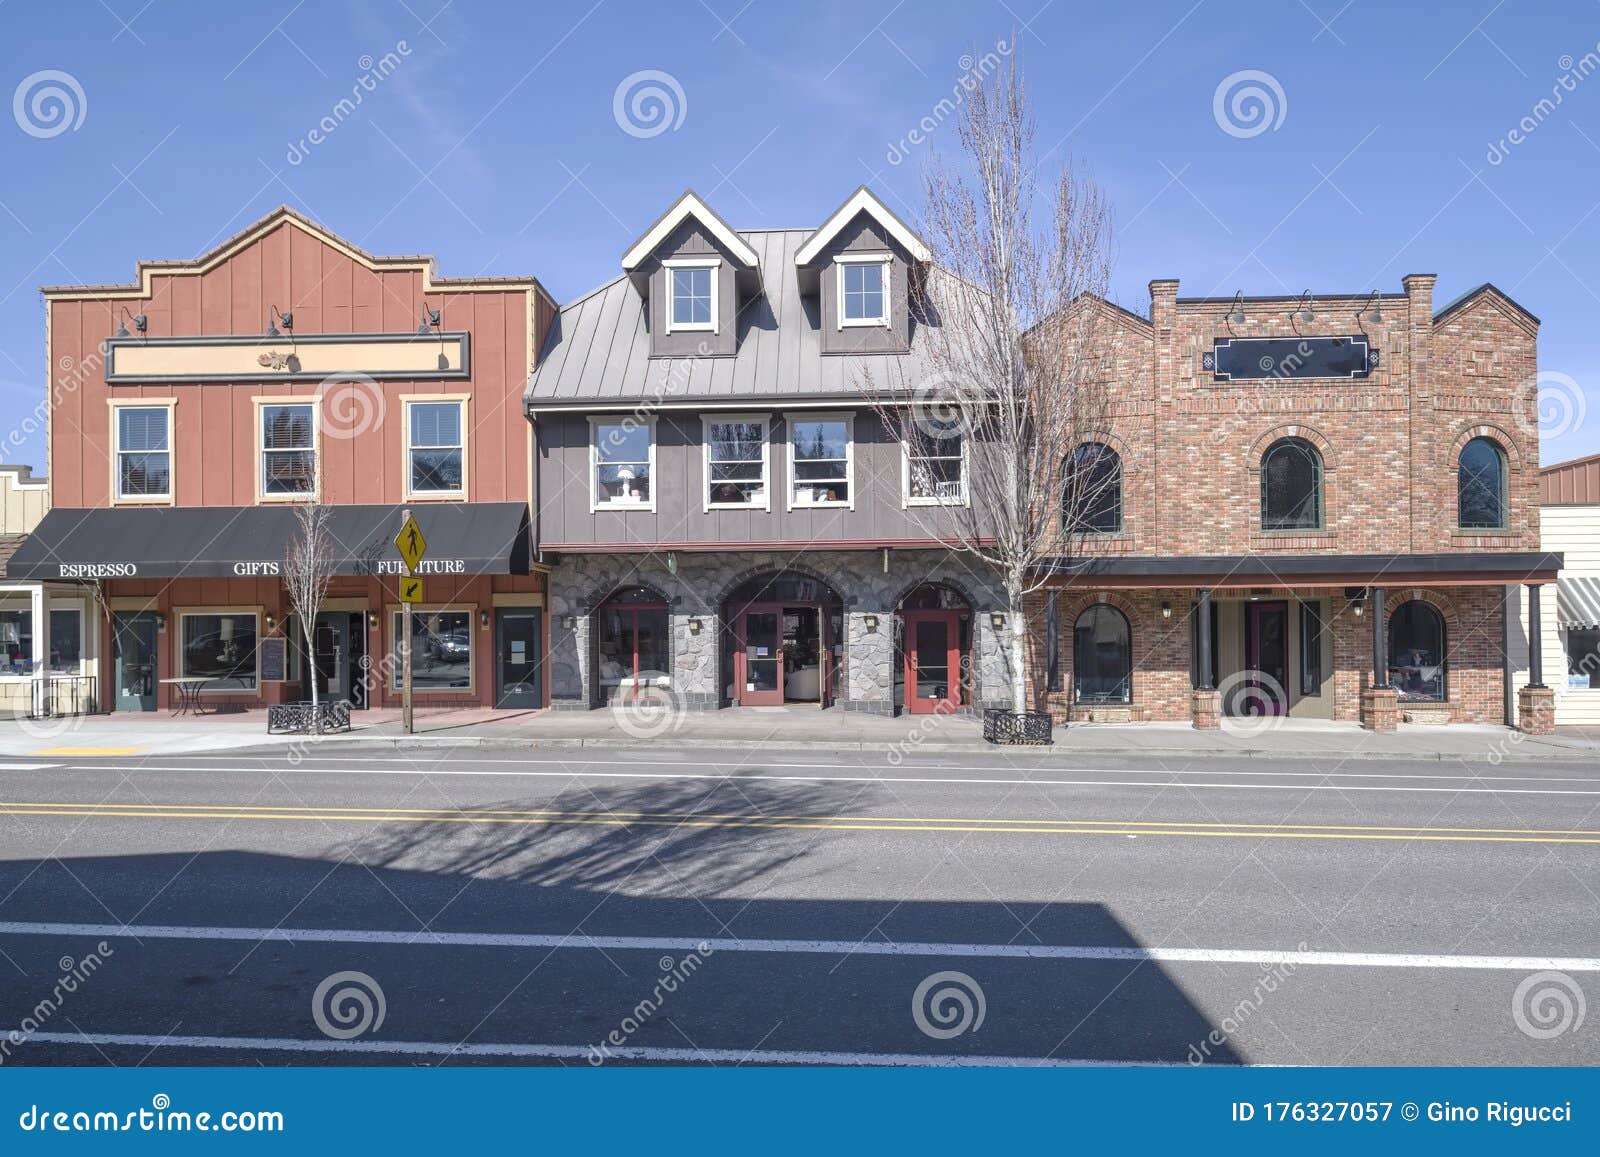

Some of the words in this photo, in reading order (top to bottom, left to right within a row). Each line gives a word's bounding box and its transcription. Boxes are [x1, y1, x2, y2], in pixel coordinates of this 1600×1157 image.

[59, 564, 136, 577] ESPRESSO
[234, 562, 279, 575] GIFTS
[378, 560, 464, 573] FUITURE
